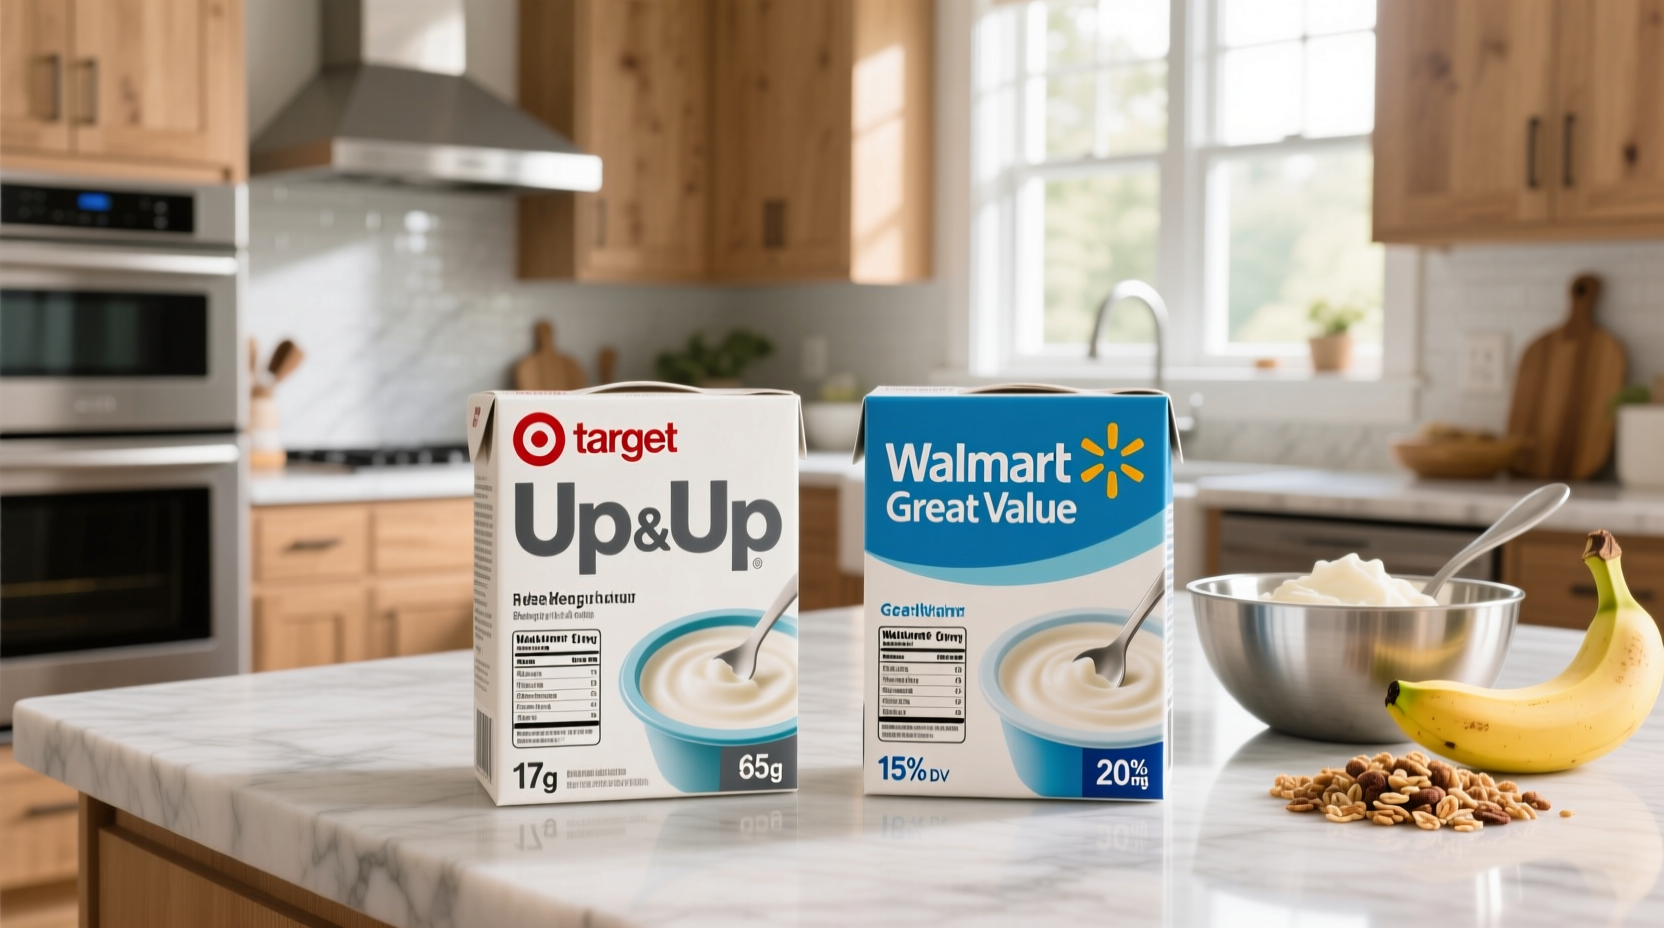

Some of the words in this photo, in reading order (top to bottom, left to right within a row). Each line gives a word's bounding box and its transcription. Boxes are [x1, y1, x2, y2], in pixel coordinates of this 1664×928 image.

[573, 422, 678, 462] target
[885, 443, 1072, 483] Walmart
[886, 491, 979, 523] Great
[983, 492, 1077, 524] Value
[514, 480, 782, 575] Up&Up
[513, 761, 558, 794] 17g
[738, 754, 783, 783] 65g
[878, 755, 927, 781] 15%
[930, 768, 950, 782] DV
[1096, 758, 1148, 786] 20%
